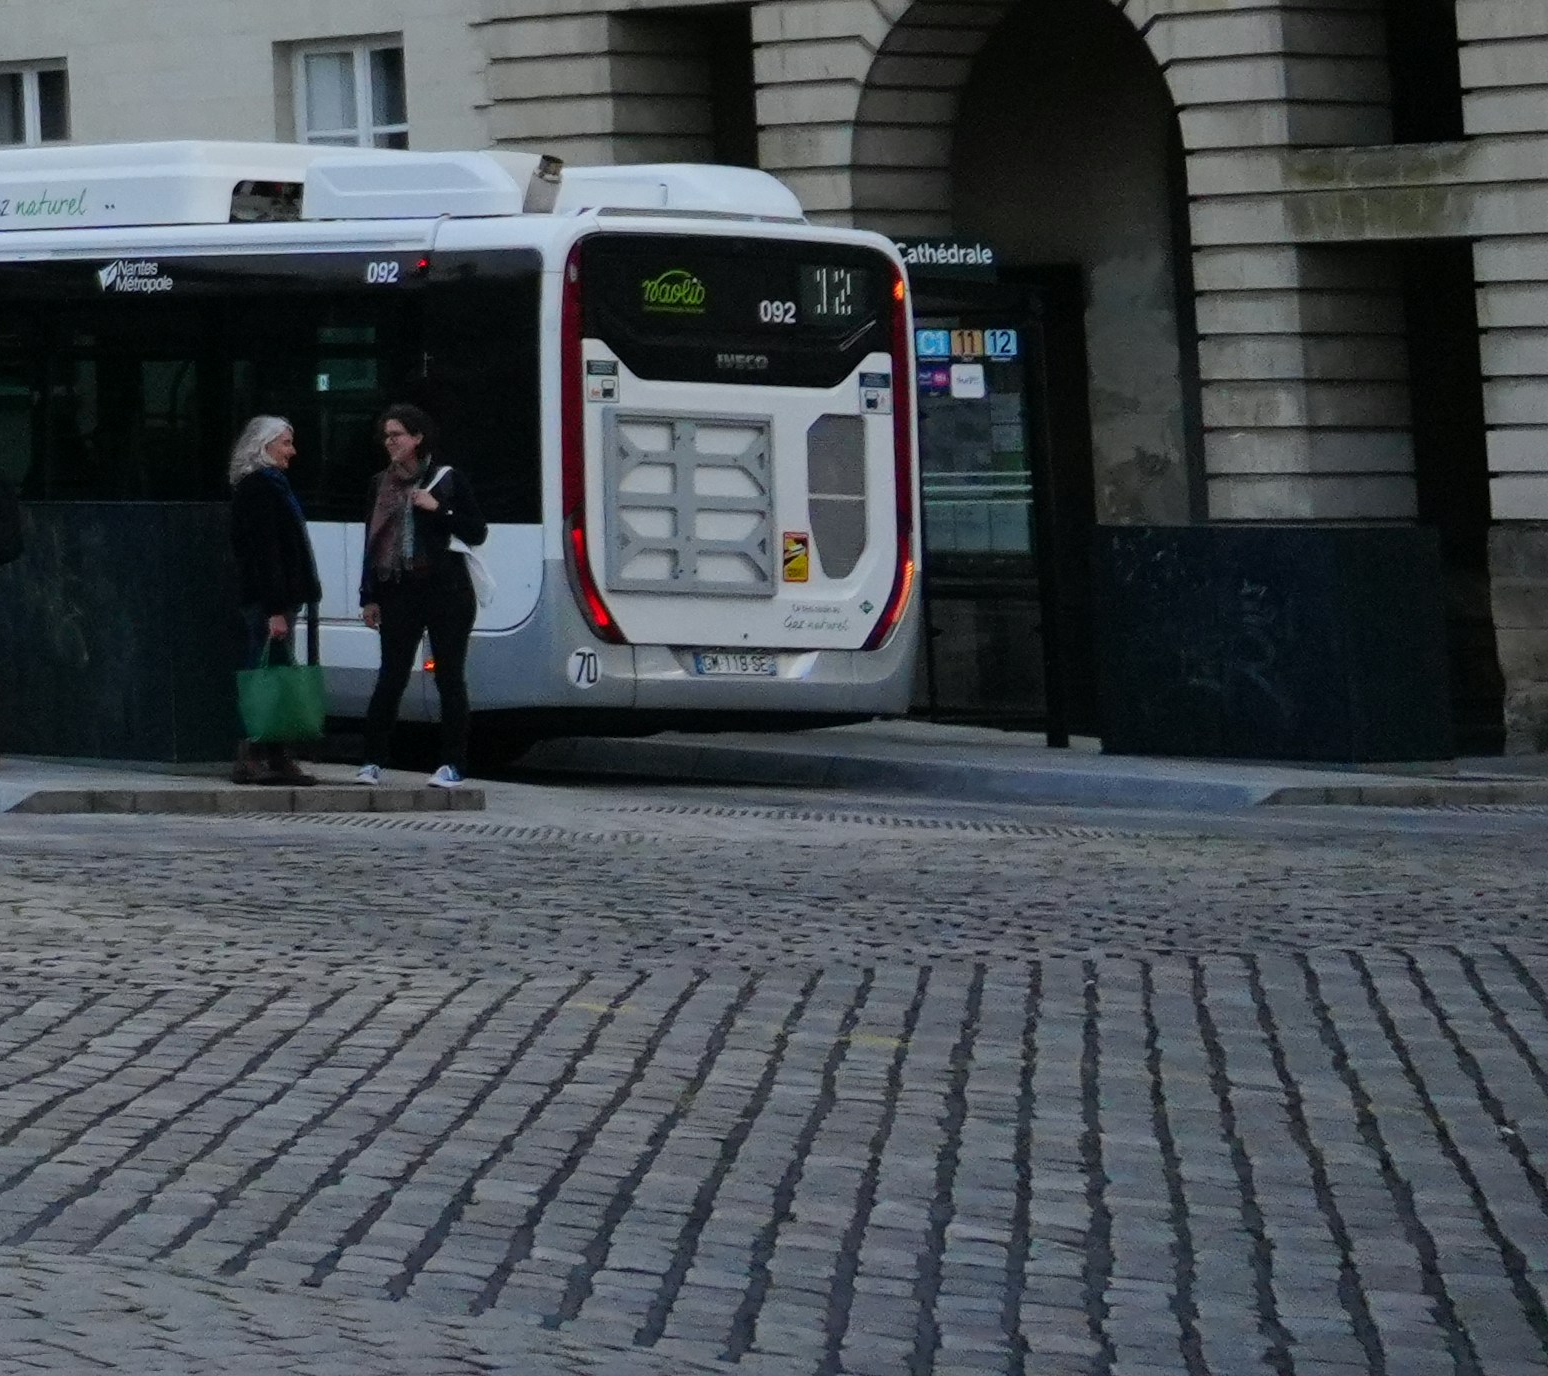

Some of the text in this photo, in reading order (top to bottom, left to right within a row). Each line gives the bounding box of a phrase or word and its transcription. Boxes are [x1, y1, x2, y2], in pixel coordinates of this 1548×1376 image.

[15, 188, 88, 217] naturel
[118, 260, 158, 276] Nantes
[367, 261, 400, 283] 092
[116, 275, 174, 293] Métropole
[816, 268, 852, 315] 12
[759, 299, 796, 324] 092
[957, 330, 975, 354] 11
[990, 330, 1012, 354] 12
[716, 354, 768, 369] IVECO
[574, 651, 598, 683] 70
